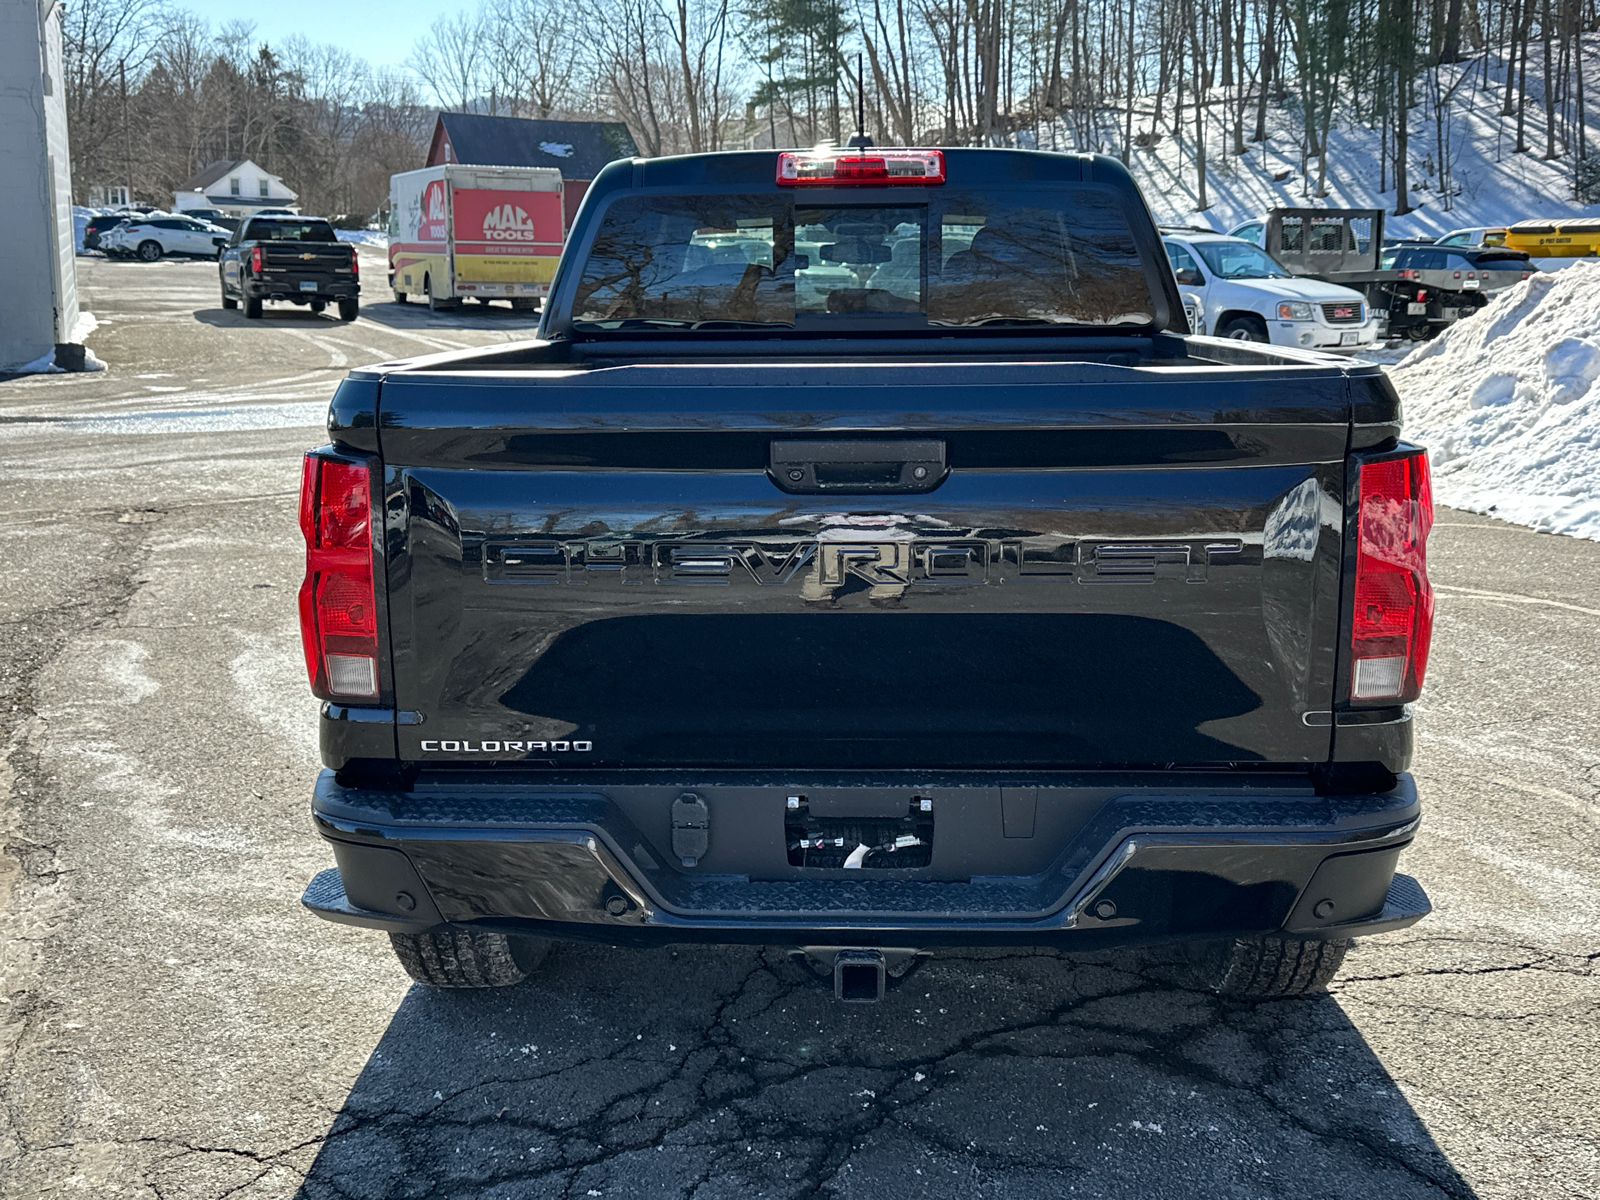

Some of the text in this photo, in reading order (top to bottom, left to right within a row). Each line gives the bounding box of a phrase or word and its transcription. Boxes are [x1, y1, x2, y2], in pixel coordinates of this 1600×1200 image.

[429, 183, 445, 221] MAC
[483, 204, 535, 231] MAC
[430, 225, 446, 239] TOOLS
[483, 230, 535, 241] TOOLS
[1334, 308, 1353, 318] GMC
[482, 538, 1244, 586] CHEVROLET
[420, 740, 593, 752] COLORADO
